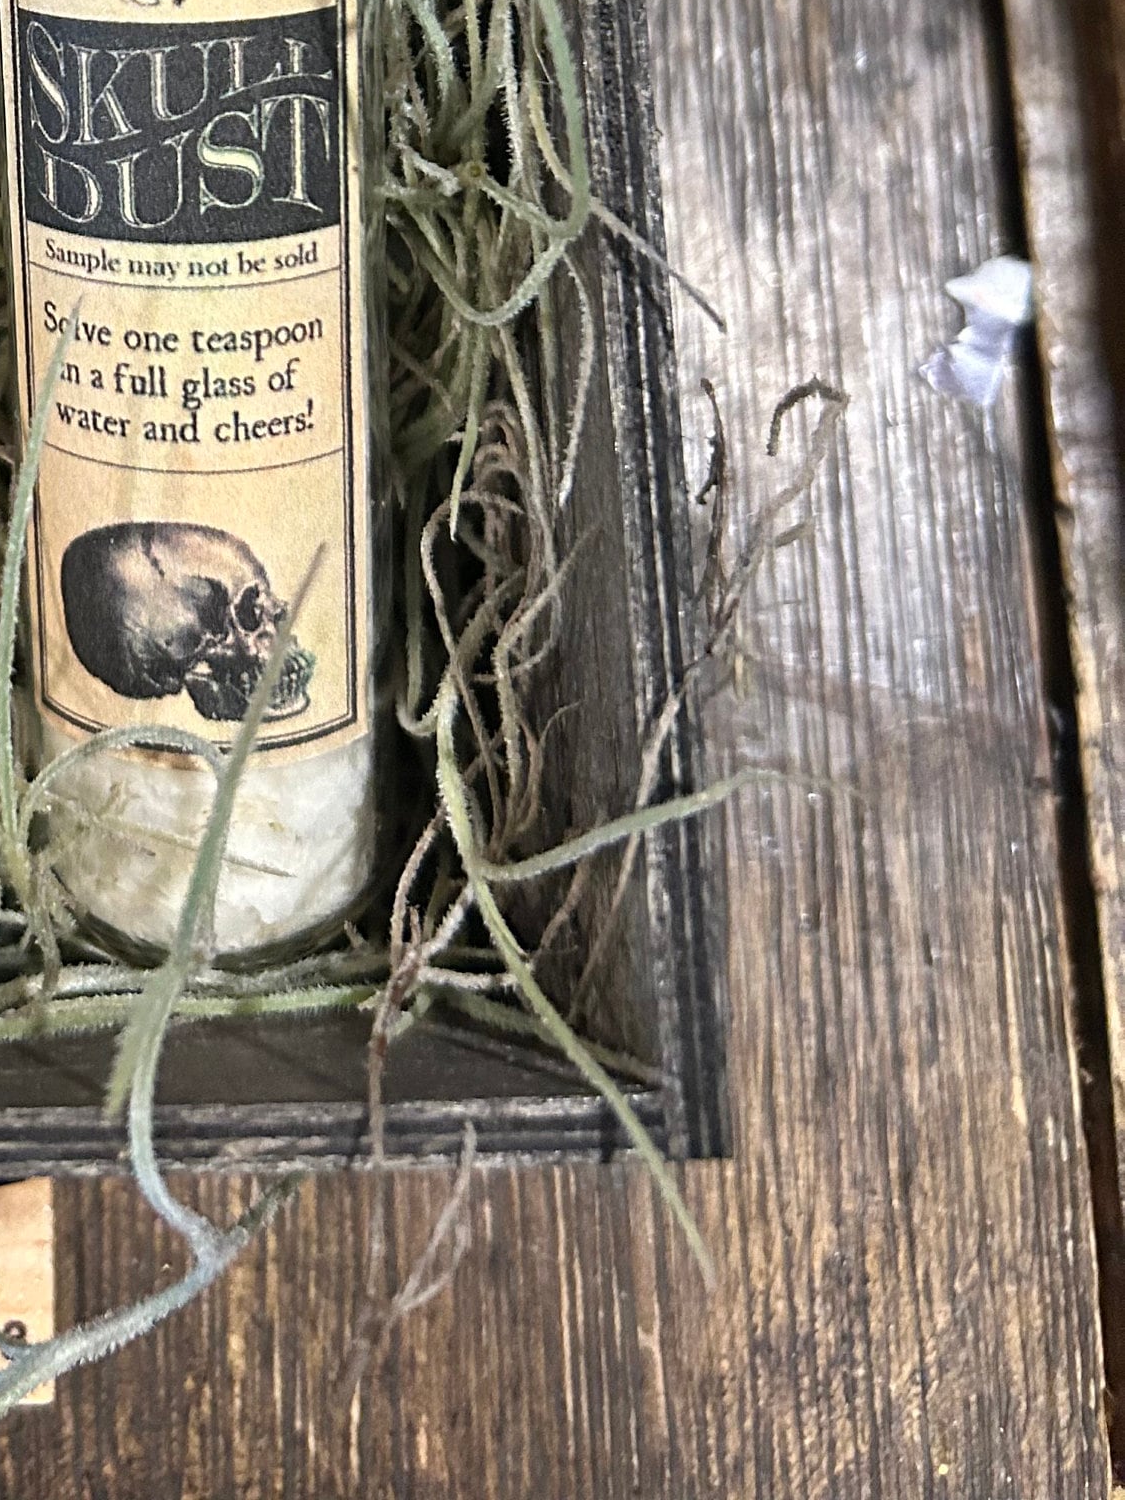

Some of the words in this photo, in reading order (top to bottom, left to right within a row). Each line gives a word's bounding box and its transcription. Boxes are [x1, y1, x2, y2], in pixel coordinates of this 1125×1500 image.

[27, 21, 333, 145] SKULL
[36, 94, 330, 229] DUST
[45, 239, 120, 273] Sample
[129, 257, 179, 281] may
[188, 257, 229, 276] not
[238, 251, 266, 274] be
[274, 242, 318, 267] sold
[124, 325, 179, 353] one
[192, 315, 323, 361] teaspoon
[91, 369, 104, 389] a
[114, 363, 168, 397] full
[182, 365, 256, 409] glass
[268, 358, 300, 390] of
[55, 400, 131, 439] water
[144, 404, 200, 442] and
[215, 399, 315, 443] cheers!
